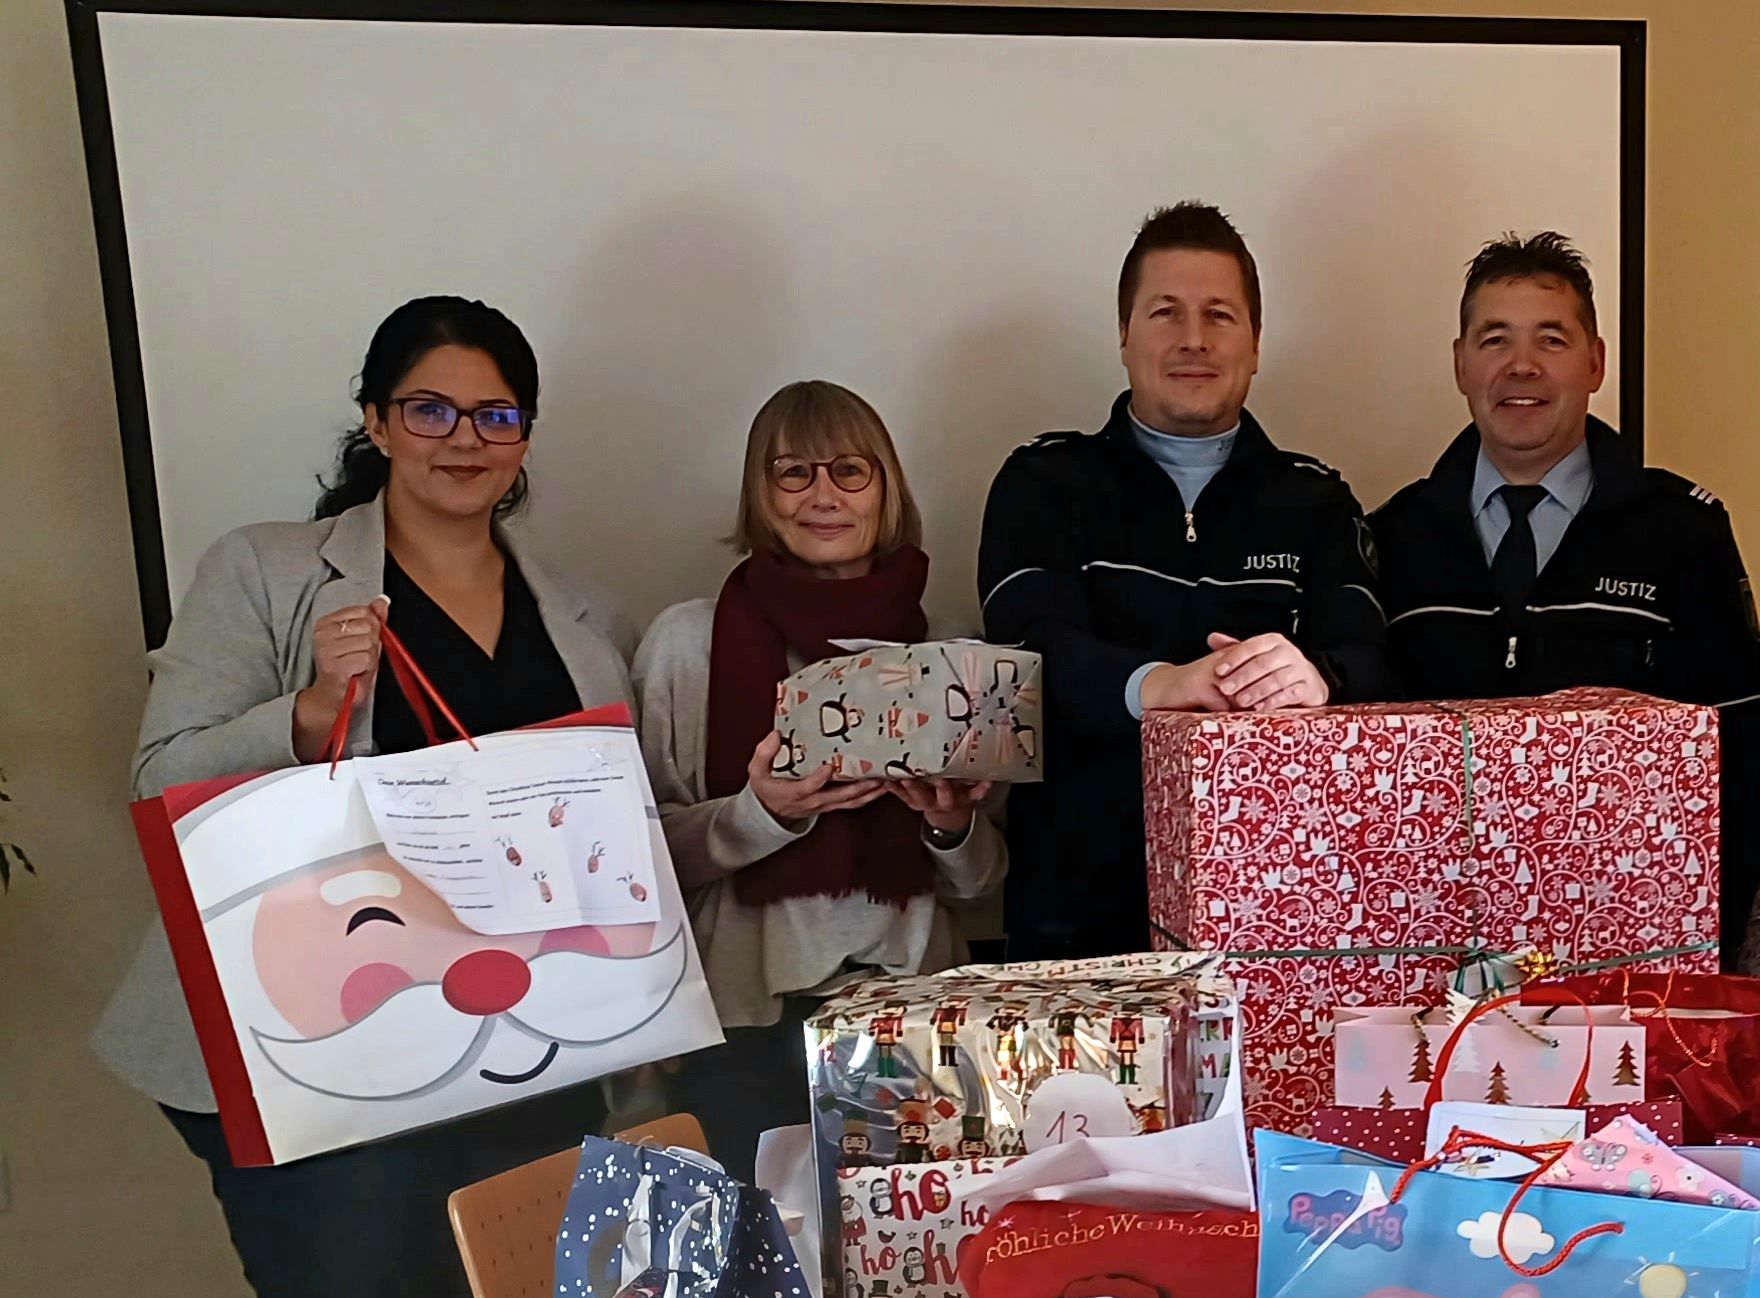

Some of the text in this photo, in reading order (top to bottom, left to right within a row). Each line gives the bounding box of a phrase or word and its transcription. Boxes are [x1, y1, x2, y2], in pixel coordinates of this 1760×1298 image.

[1242, 553, 1300, 573] JUSTIZ
[1595, 577, 1657, 600] JUSTIZ
[1046, 1111, 1090, 1138] 13
[891, 1167, 952, 1221] ho
[923, 1229, 960, 1285] h
[984, 1222, 1106, 1265] röhliche
[860, 1244, 902, 1276] ho
